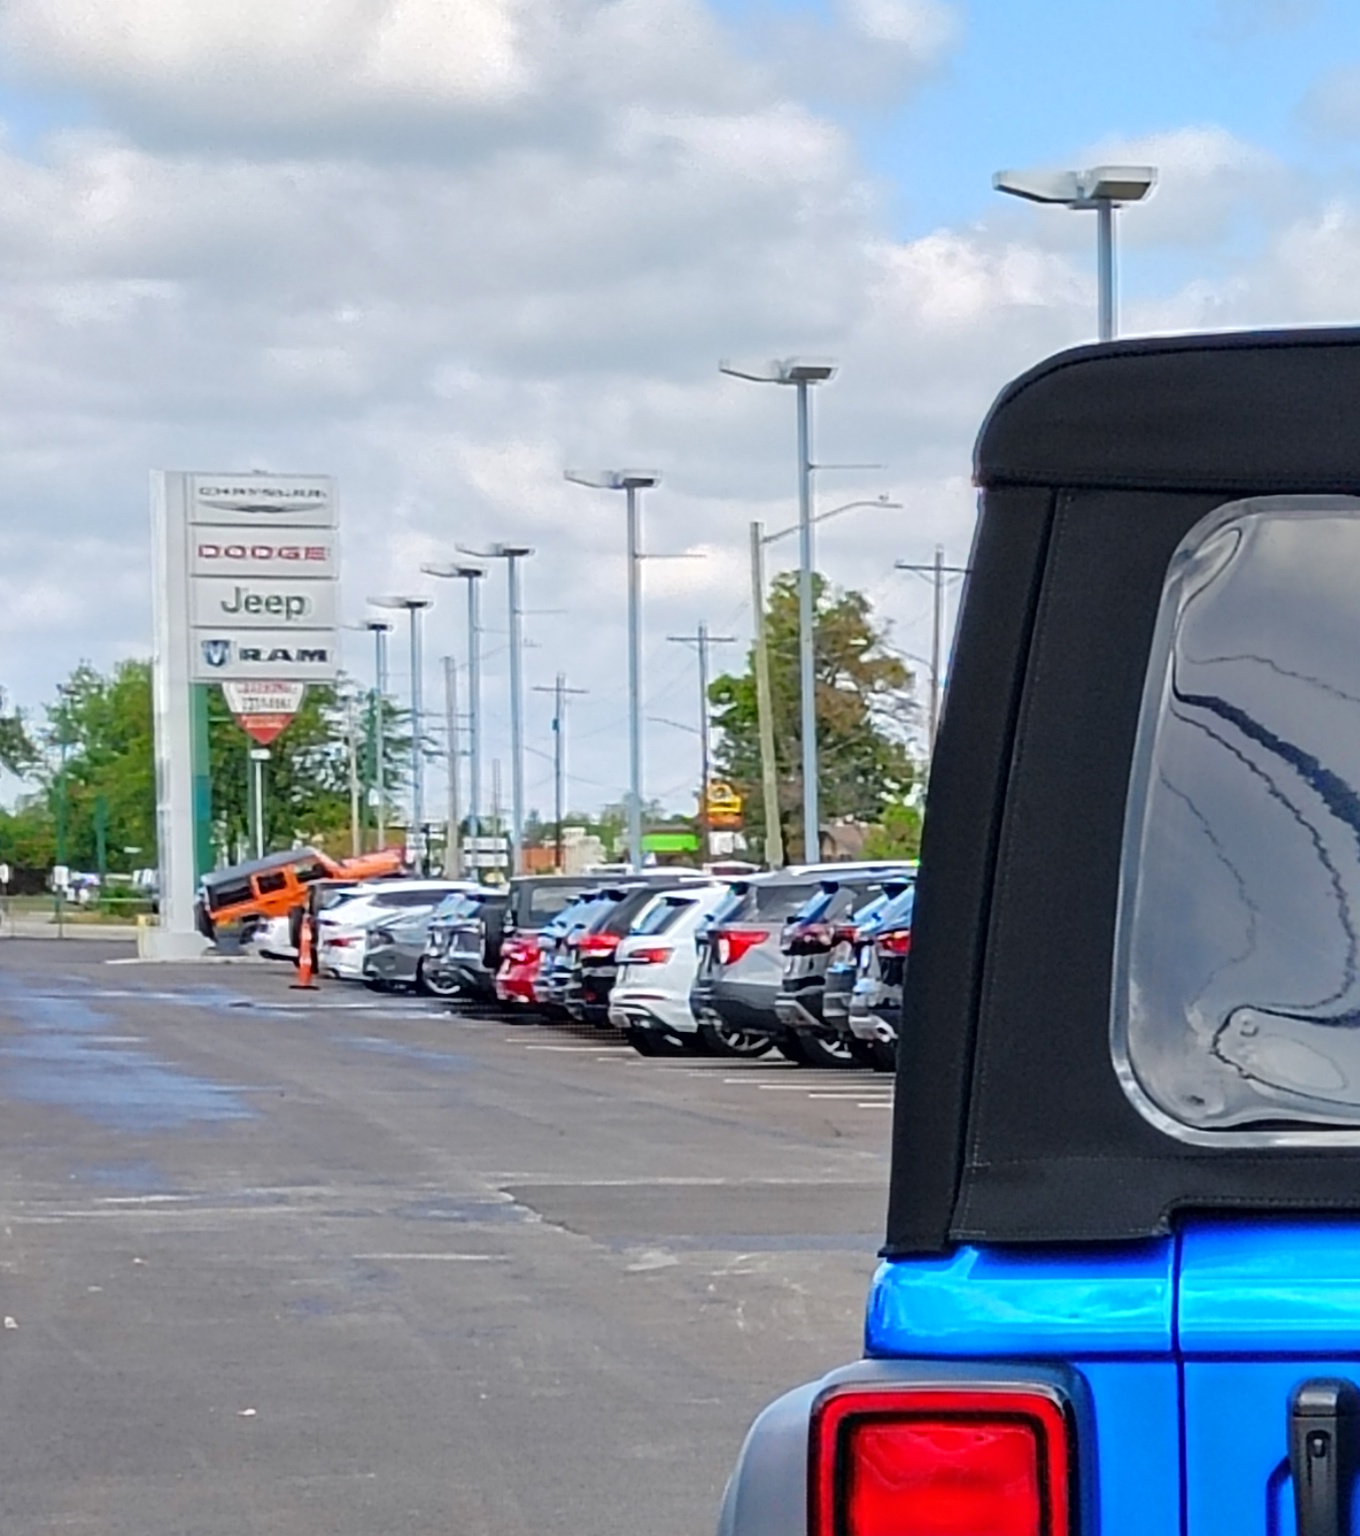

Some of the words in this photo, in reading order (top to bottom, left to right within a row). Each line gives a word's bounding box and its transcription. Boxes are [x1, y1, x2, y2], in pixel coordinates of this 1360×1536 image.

[199, 544, 327, 561] DODGE
[220, 586, 306, 621] Jeep
[239, 648, 328, 663] RAM
